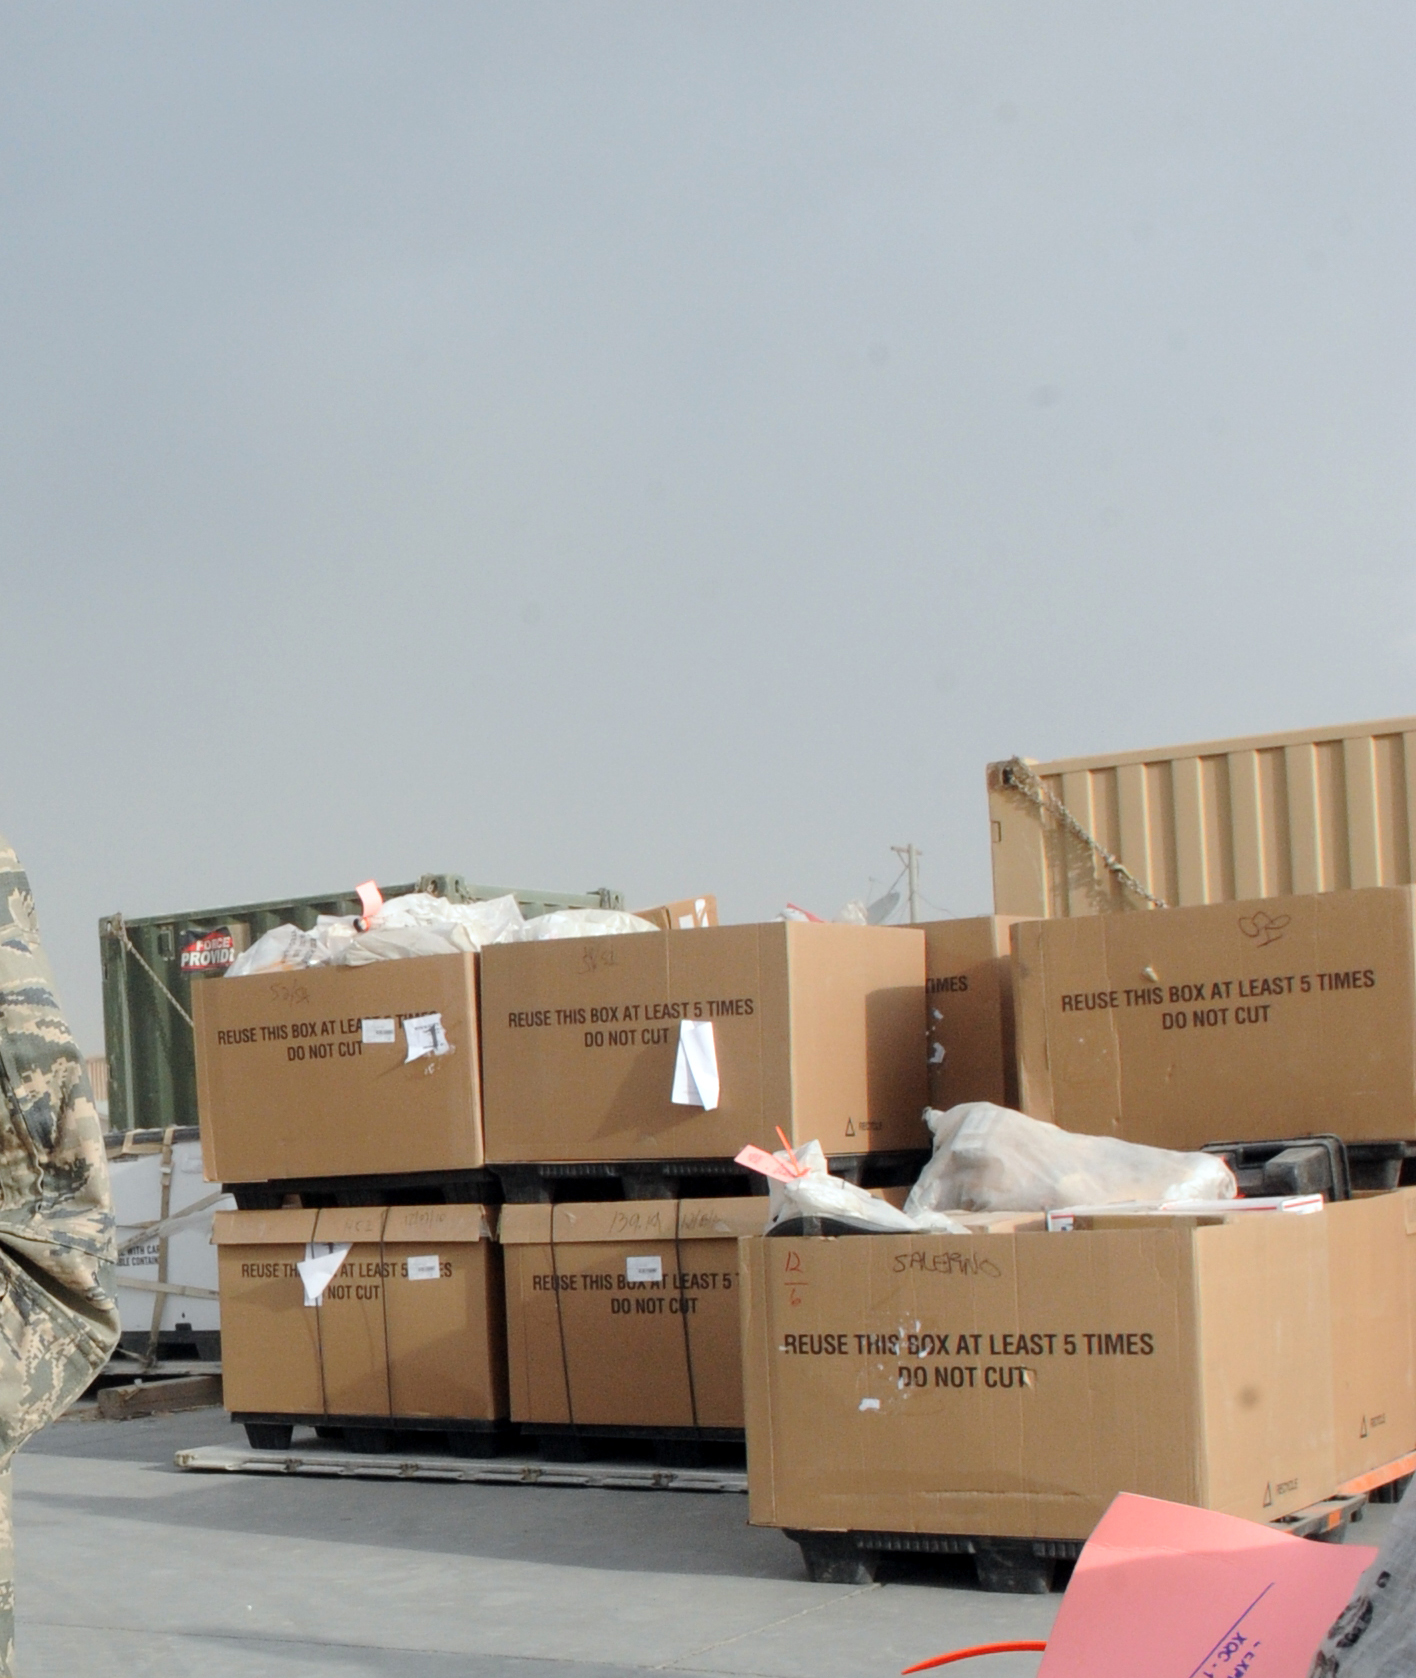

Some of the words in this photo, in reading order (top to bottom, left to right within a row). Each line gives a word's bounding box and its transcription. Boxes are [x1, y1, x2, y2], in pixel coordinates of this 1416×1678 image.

[1061, 992, 1119, 1013] REUSE
[1124, 988, 1164, 1008] THIS
[1169, 984, 1207, 1004] BOX
[1211, 982, 1233, 1000] AT
[1238, 977, 1294, 998] LEAST
[1300, 975, 1311, 993] 5
[1316, 970, 1375, 991] TIMES
[508, 1010, 551, 1028] REUSE
[555, 1008, 585, 1025] THIS
[590, 1006, 619, 1024] BOX
[623, 1004, 640, 1022] AT
[645, 1002, 689, 1020] LEAST
[694, 1001, 703, 1018] 5
[706, 998, 754, 1016] TIMES
[1162, 1012, 1187, 1030] DO
[1192, 1009, 1229, 1028] NOT
[1234, 1005, 1271, 1024] CUT
[217, 1027, 257, 1045] REUSE
[260, 1024, 288, 1041] THIS
[292, 1021, 317, 1038] BOX
[320, 1020, 336, 1036] AT
[340, 1016, 378, 1034] LEA
[585, 1032, 604, 1048] DO
[608, 1029, 638, 1046] NOT
[641, 1027, 671, 1045] CUT
[287, 1046, 306, 1062] DO
[309, 1043, 335, 1059] NOT
[338, 1041, 362, 1056] CUT
[242, 1263, 279, 1278] REUSE
[340, 1263, 355, 1277] AT
[359, 1262, 397, 1278] LEAST
[400, 1262, 408, 1278] 5
[328, 1285, 353, 1300] NOT
[356, 1285, 380, 1300] CUT
[533, 1274, 577, 1291] REUSE
[581, 1274, 612, 1290] THIS
[673, 1273, 718, 1289] LEAST
[722, 1273, 732, 1289] 5
[611, 1299, 631, 1314] DO
[636, 1298, 665, 1314] NOT
[669, 1298, 698, 1314] CUT
[784, 1334, 848, 1355] REUSE
[853, 1334, 900, 1355] THIS
[907, 1334, 949, 1355] BOX
[955, 1334, 982, 1355] AT
[990, 1333, 1057, 1355] LEAST
[1064, 1333, 1076, 1355] 5
[1083, 1333, 1154, 1355] TIMES
[898, 1366, 928, 1388] DO
[935, 1366, 977, 1388] NOT
[985, 1366, 1028, 1388] CUT
